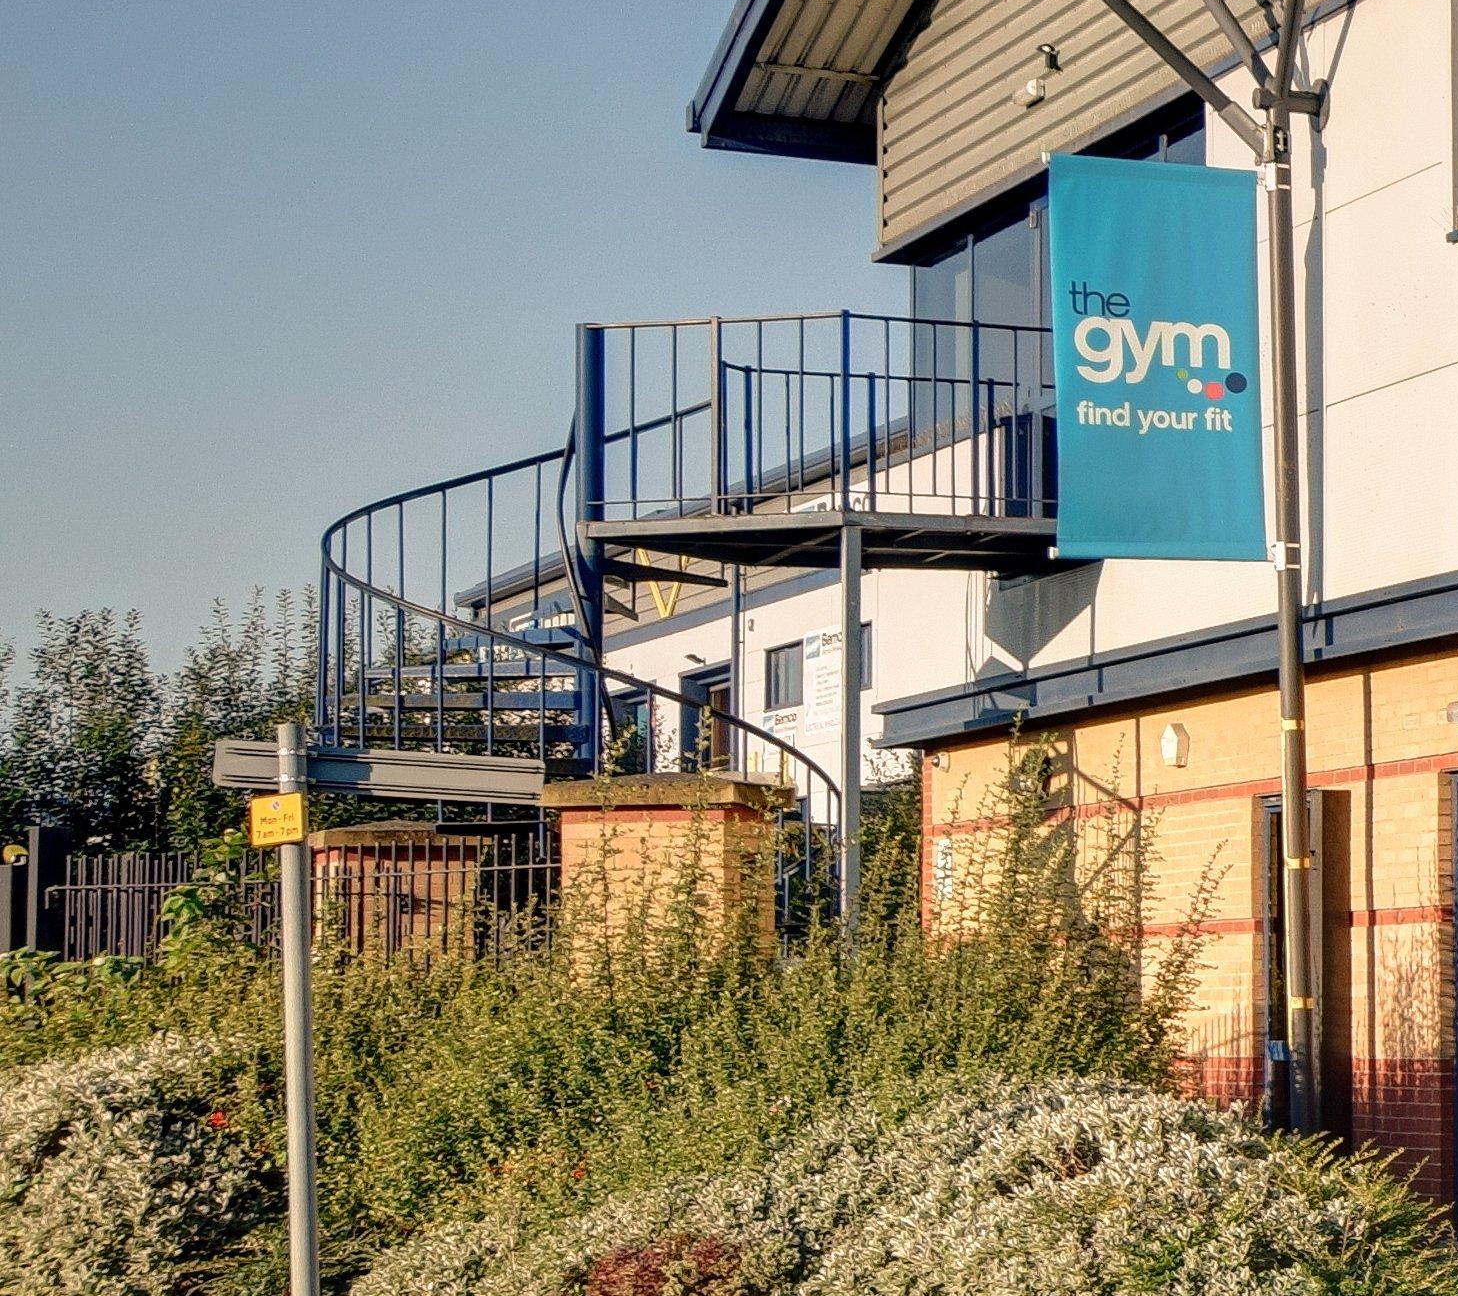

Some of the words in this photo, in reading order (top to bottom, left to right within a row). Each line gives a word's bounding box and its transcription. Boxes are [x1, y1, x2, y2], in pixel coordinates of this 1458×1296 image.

[1069, 281, 1130, 317] the
[1074, 316, 1231, 384] gym
[1077, 400, 1130, 427] find
[1137, 408, 1198, 435] your
[1204, 406, 1232, 432] fit
[283, 812, 295, 823] Fri
